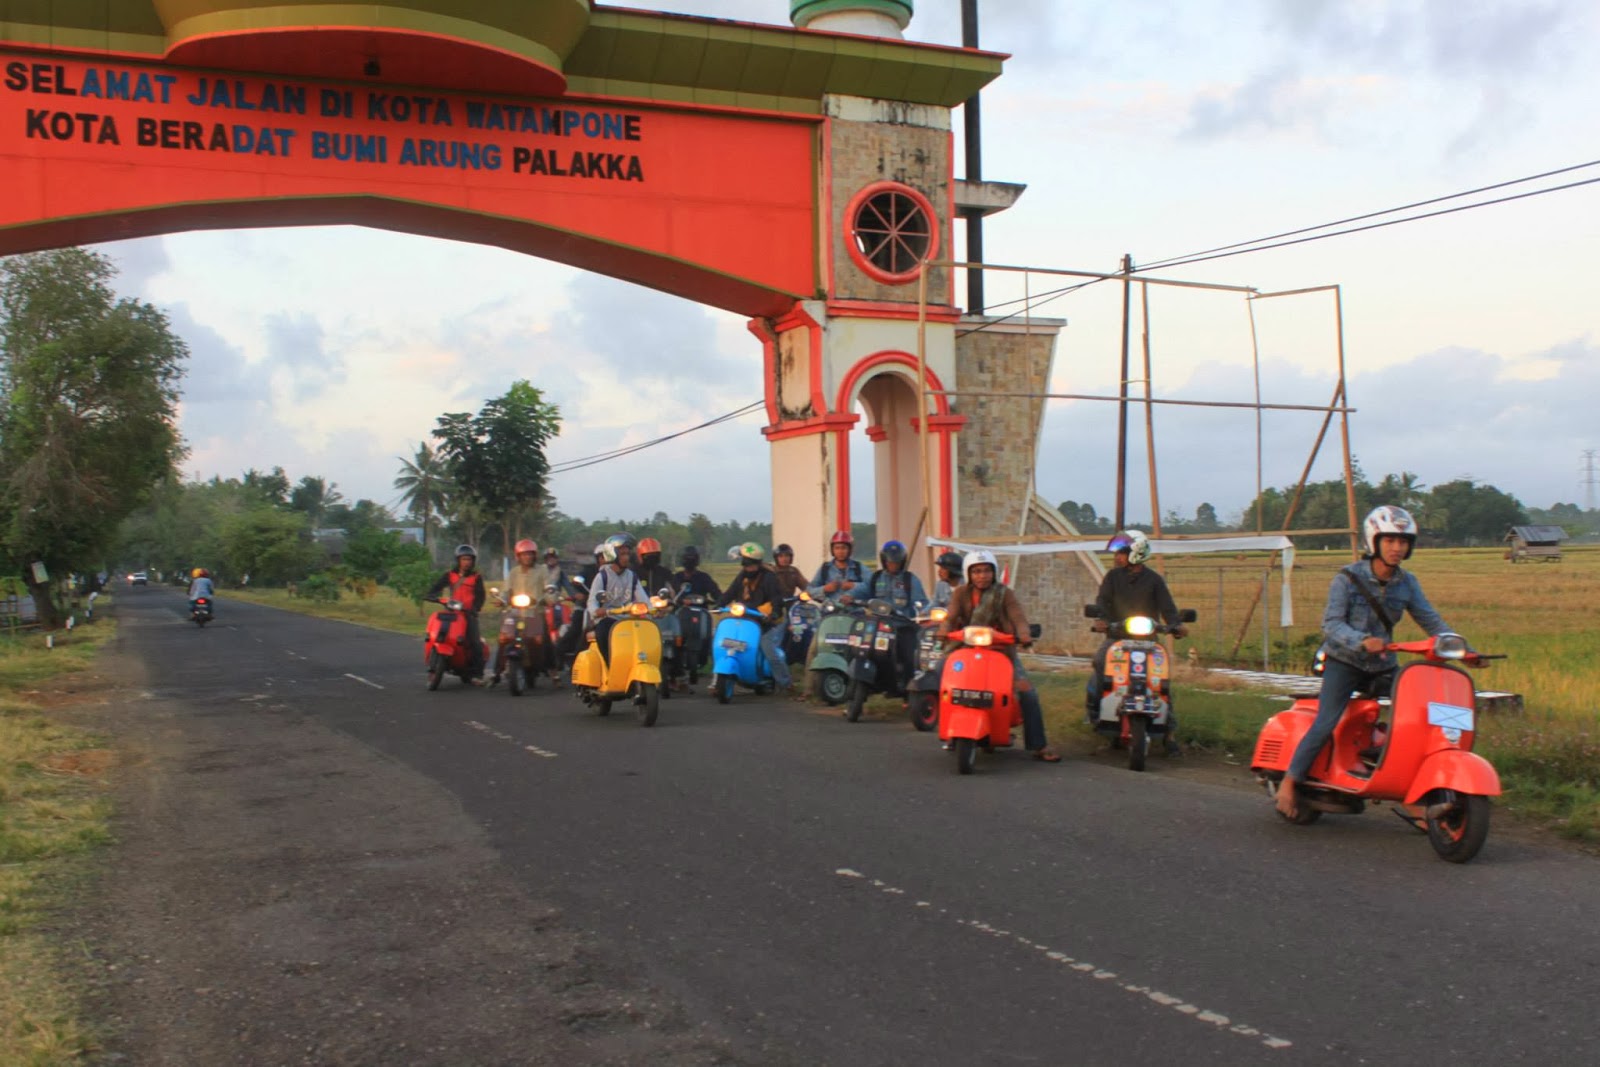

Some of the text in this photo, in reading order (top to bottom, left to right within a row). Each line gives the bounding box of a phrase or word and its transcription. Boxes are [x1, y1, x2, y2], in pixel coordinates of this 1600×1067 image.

[5, 62, 641, 141] SELAMAT JALAN DI KOTA WATAMPONE
[26, 109, 644, 182] KOTA BERADAT BUMI ARUNG PALAKKA
